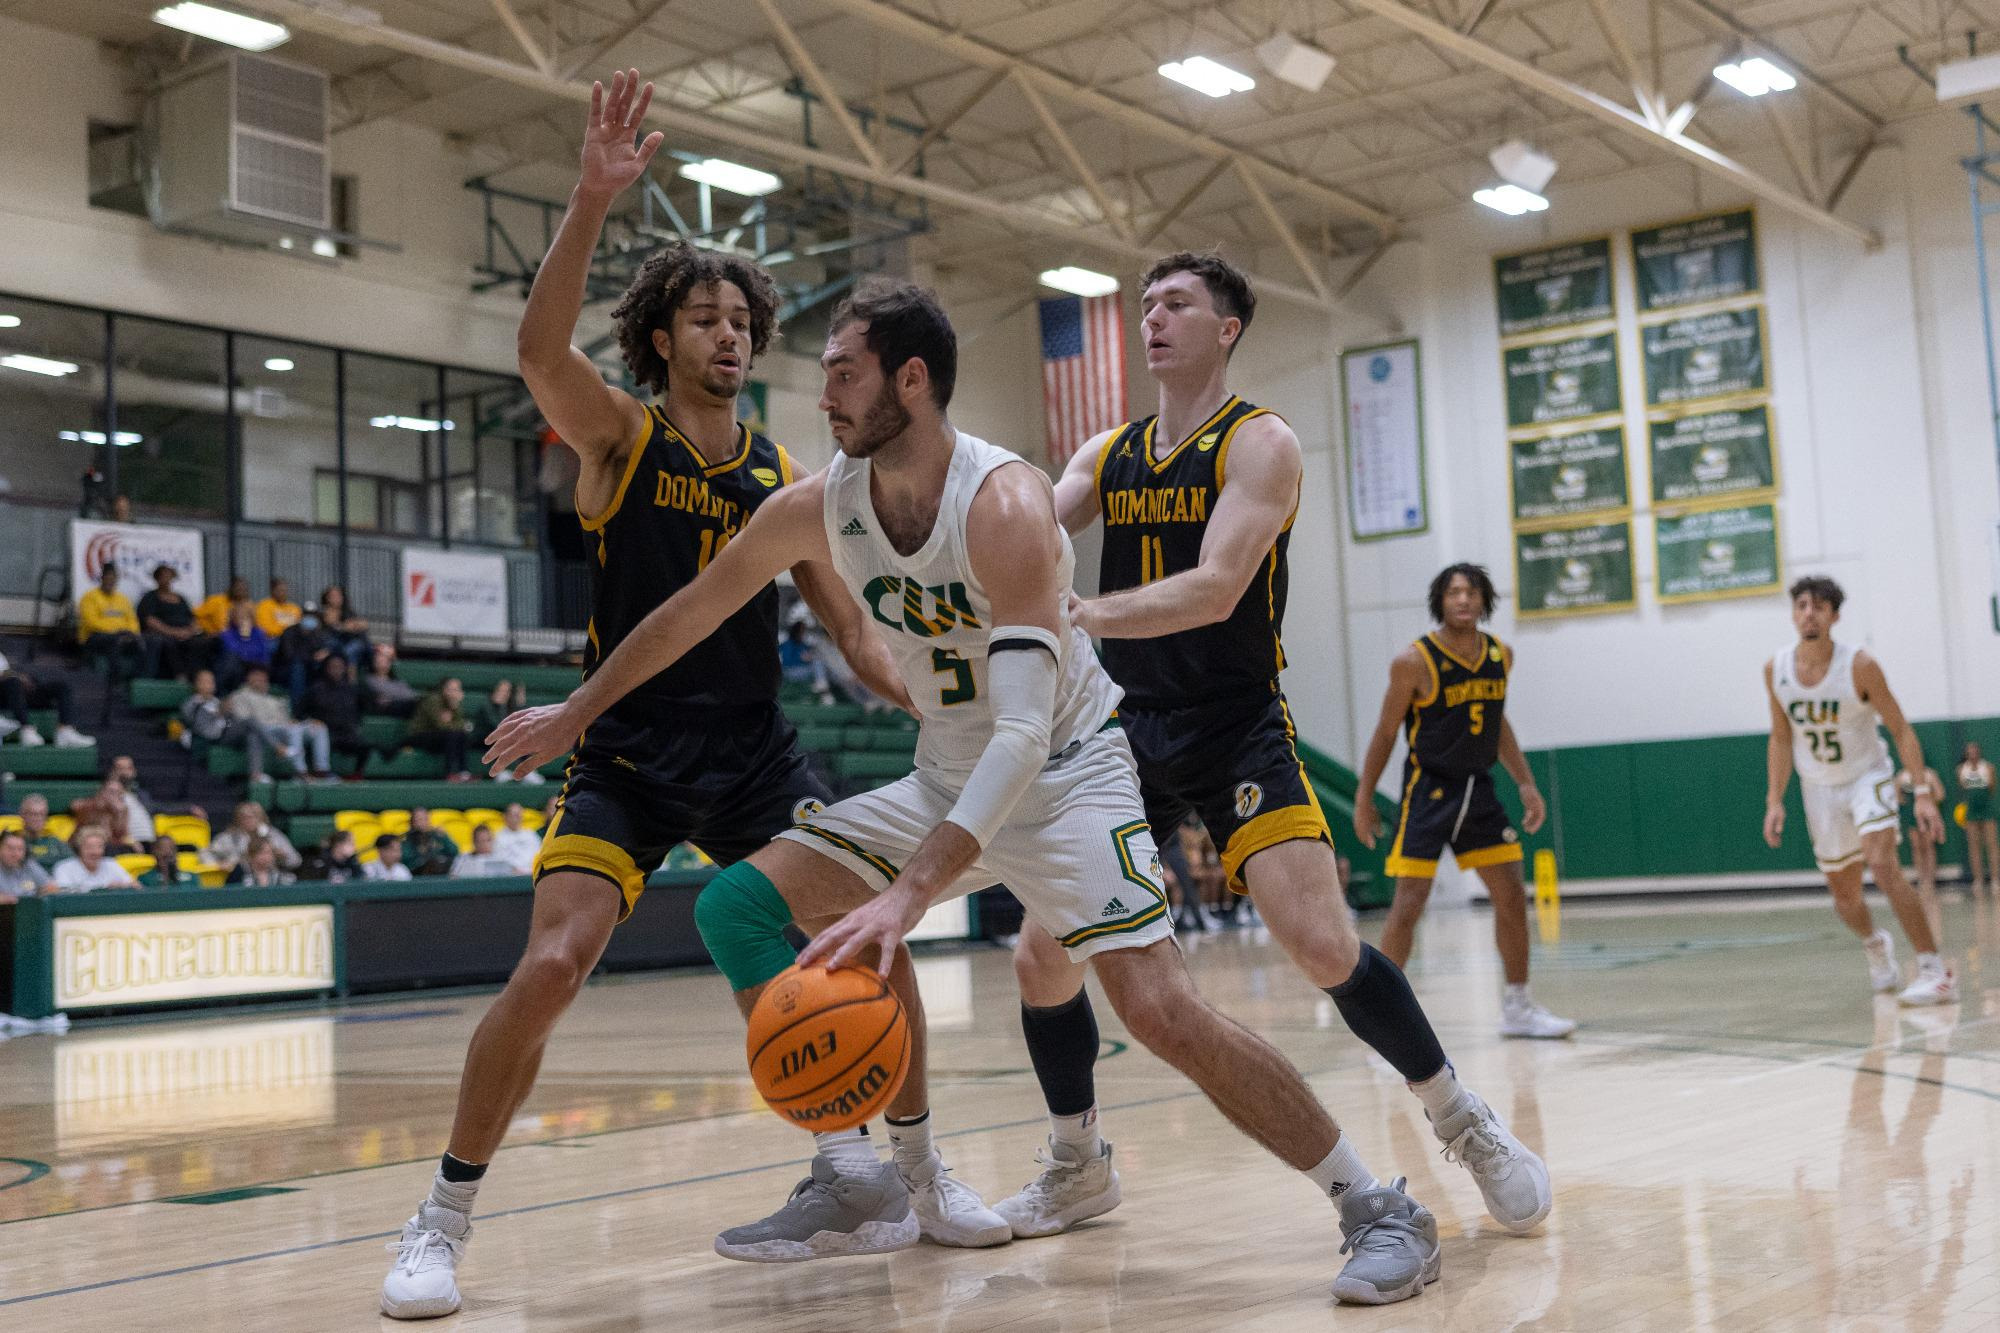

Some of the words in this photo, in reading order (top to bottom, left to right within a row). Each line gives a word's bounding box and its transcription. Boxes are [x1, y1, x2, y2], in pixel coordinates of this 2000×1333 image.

[1106, 487, 1207, 527] DOMNICAN
[841, 528, 868, 536] adidas
[1141, 535, 1164, 585] 11
[932, 647, 977, 708] 5
[1469, 702, 1484, 735] 5
[1789, 701, 1839, 724] CUI
[1804, 731, 1843, 763] 25
[1101, 907, 1130, 917] adidas
[64, 916, 333, 997] CONCORDIA
[781, 1030, 836, 1080] EVO
[787, 1064, 890, 1122] Wilson
